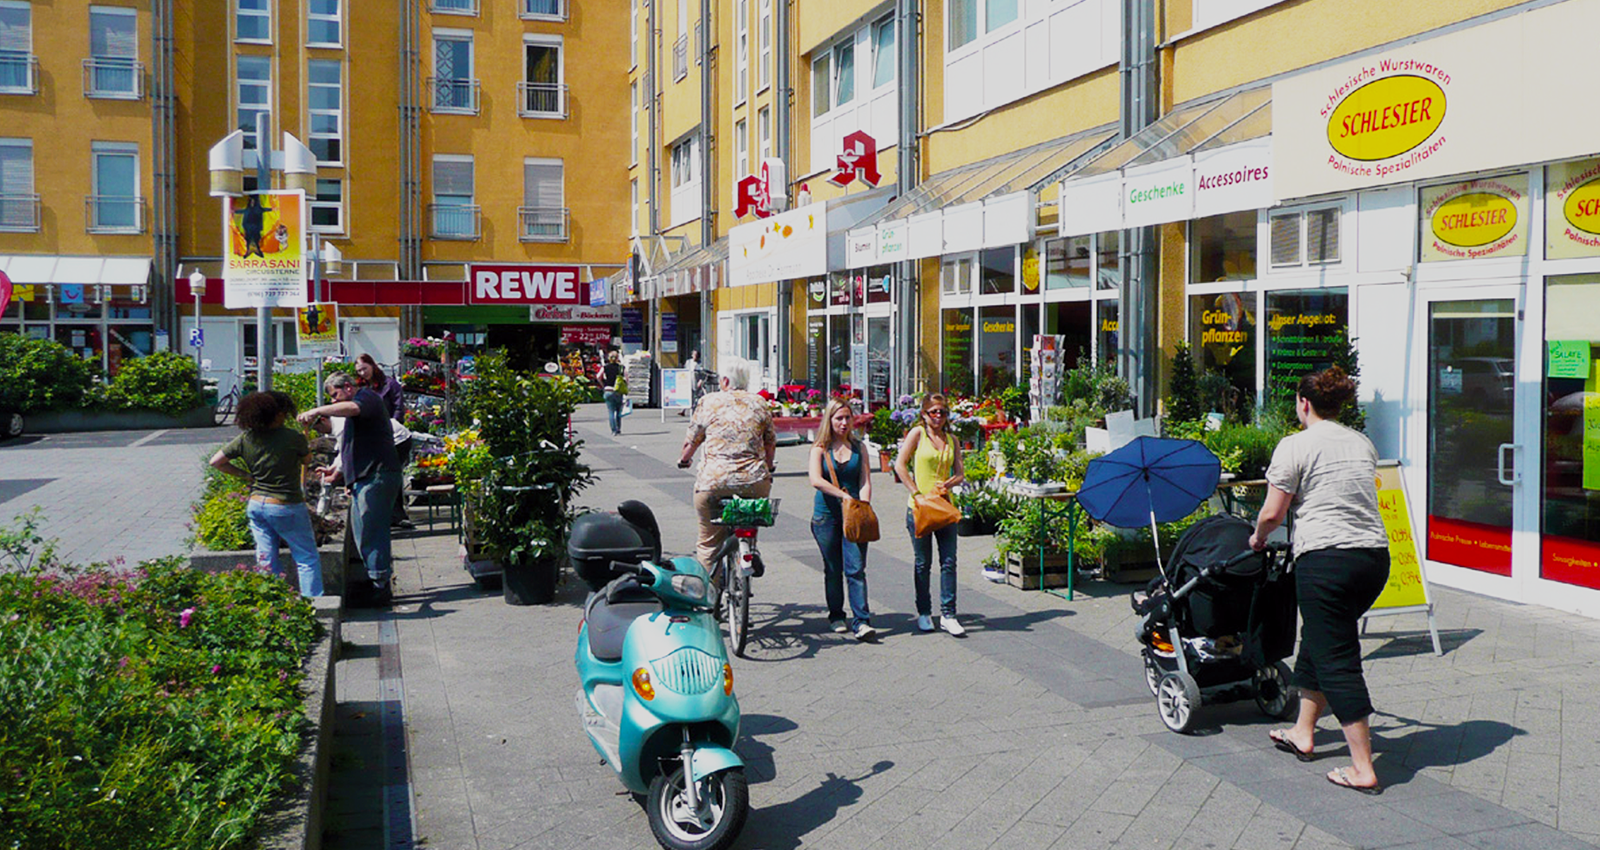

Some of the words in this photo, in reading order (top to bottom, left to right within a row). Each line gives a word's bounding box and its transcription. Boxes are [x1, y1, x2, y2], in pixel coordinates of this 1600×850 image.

[1320, 66, 1376, 119] Schlesische
[1379, 58, 1452, 86] Wurstwaren
[1340, 96, 1432, 138] SCHLESIER
[1327, 154, 1372, 176] Polnische
[1375, 136, 1447, 178] Spezialitäten
[1198, 165, 1269, 191] Accessoires
[1129, 181, 1185, 204] Geschenke
[1440, 208, 1508, 231] SCHLESIER
[1432, 241, 1466, 257] Polnische
[229, 259, 300, 269] SARRASANI
[476, 271, 576, 299] REWE
[1202, 310, 1232, 325] Grün-
[1201, 328, 1248, 348] pflanzen
[1478, 540, 1512, 553] Lebensmitte
